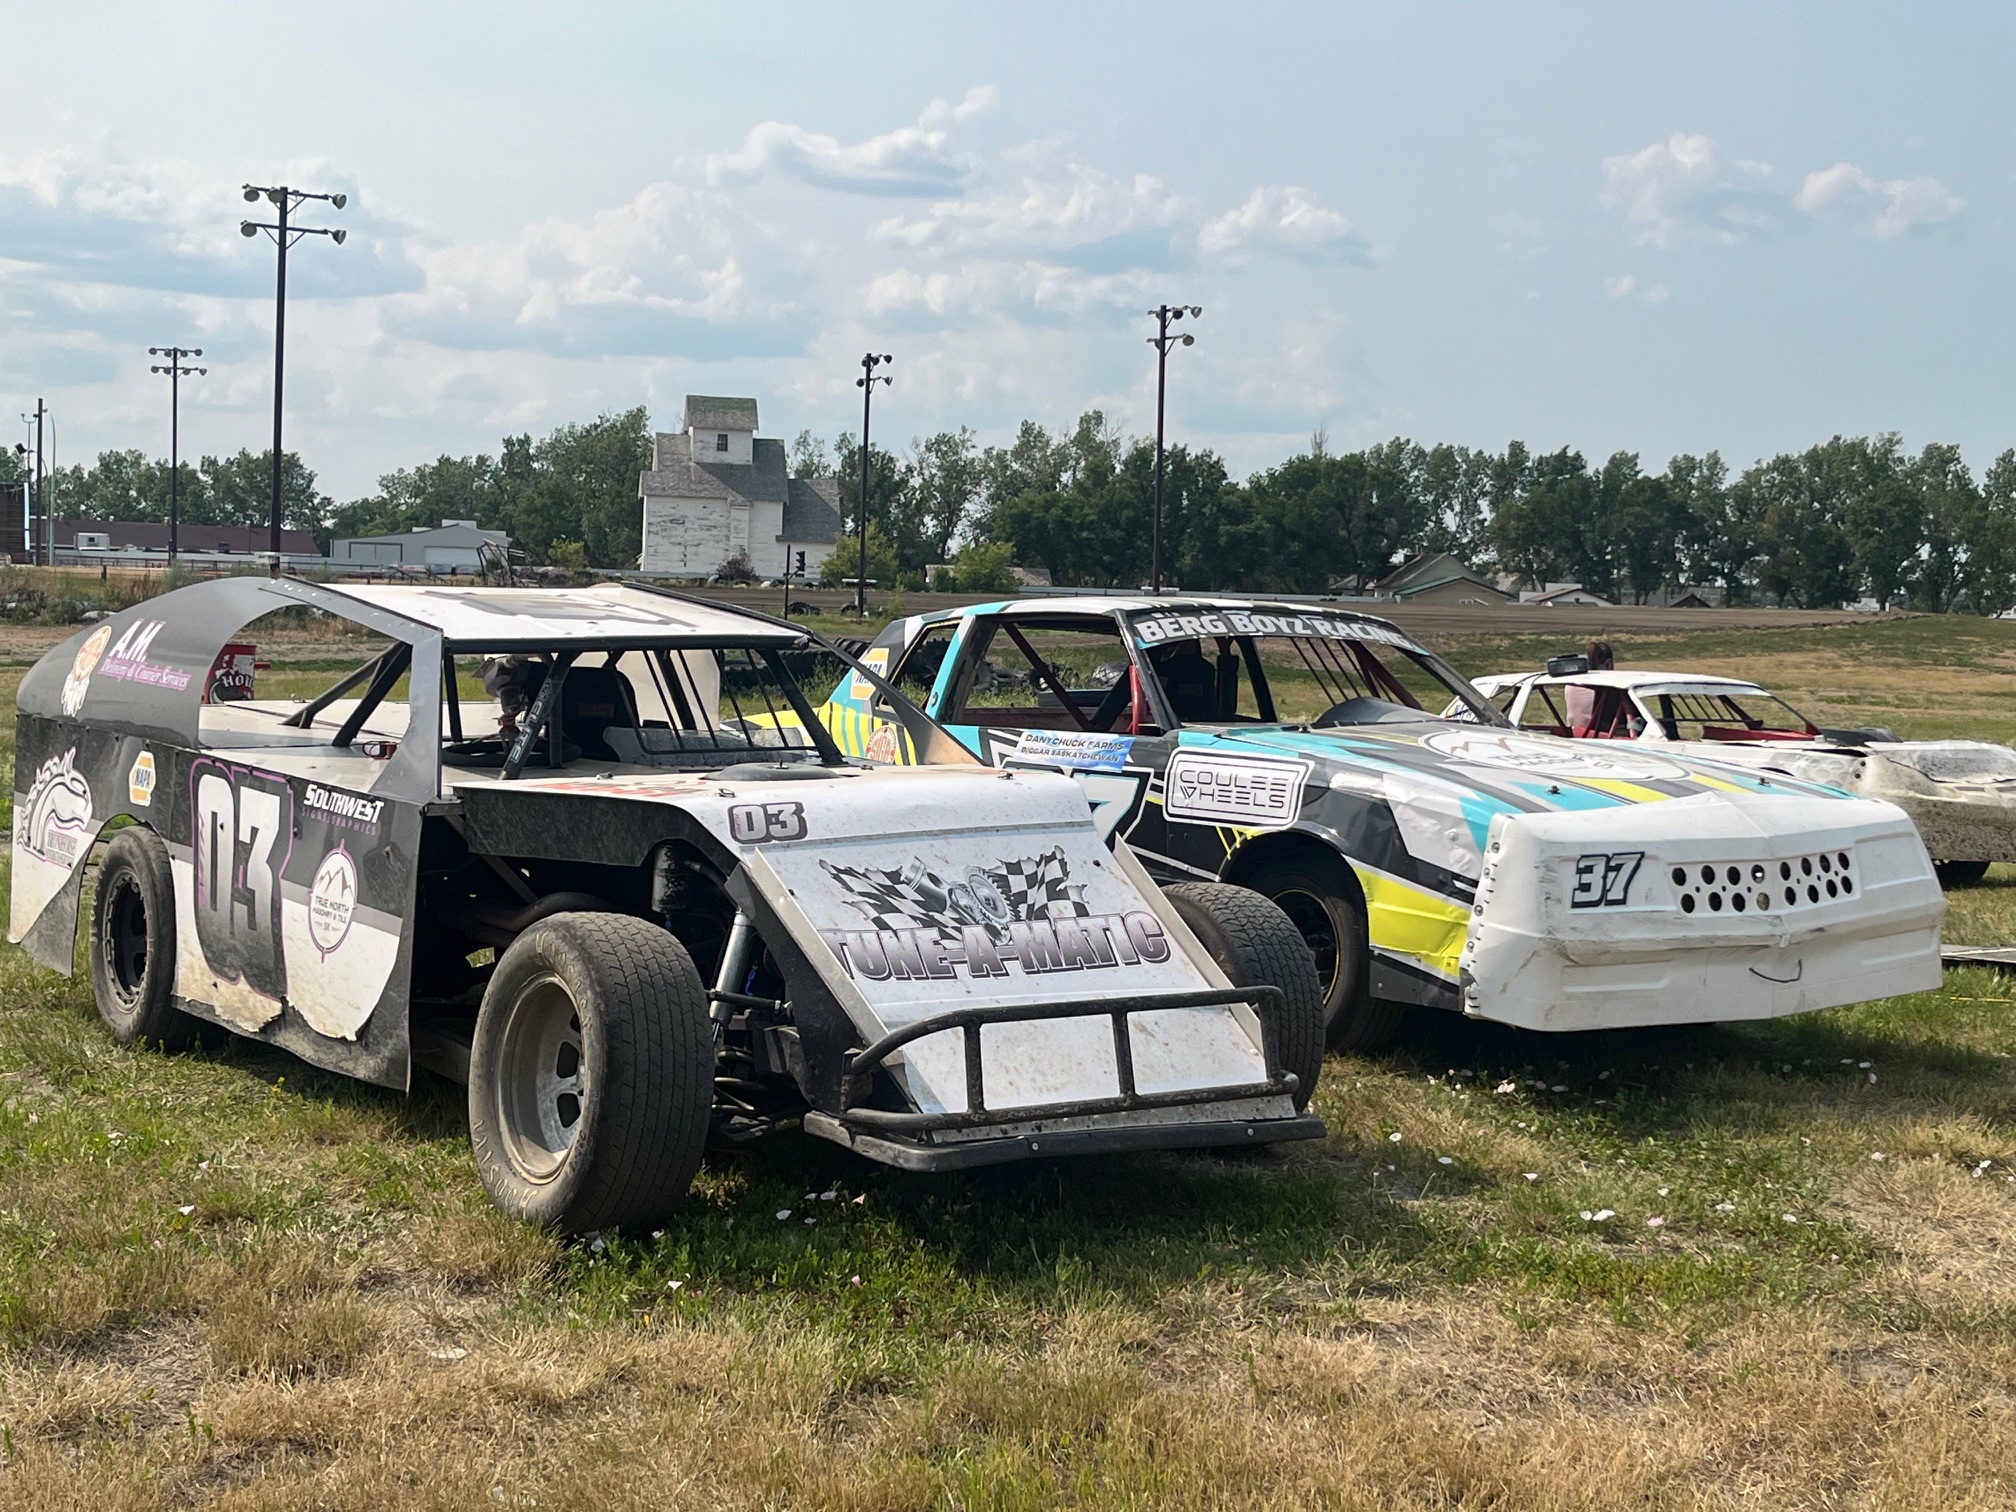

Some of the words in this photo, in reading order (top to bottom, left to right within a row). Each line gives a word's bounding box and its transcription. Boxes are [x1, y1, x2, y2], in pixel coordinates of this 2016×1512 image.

[108, 618, 167, 662] A.M.
[1135, 614, 1228, 643] BERG
[1230, 613, 1313, 635] BOYZ
[1313, 618, 1412, 648] RACING
[1020, 746, 1050, 756] BIGGAR
[1050, 750, 1119, 762] SASKATCHEWAN
[1025, 734, 1086, 748] DANYCHUCK
[1087, 741, 1124, 751] FARMS
[135, 767, 151, 789] NAPA
[1180, 769, 1289, 791] COULEE
[303, 783, 384, 823] SOUTHWEST
[1180, 785, 1286, 809] WHEELS
[727, 801, 809, 845] 03
[195, 768, 285, 985] 03
[1570, 850, 1645, 909] 37
[315, 895, 328, 908] TRUE
[329, 901, 350, 915] NORTH
[819, 911, 1173, 981] TUNE-A-MATIC
